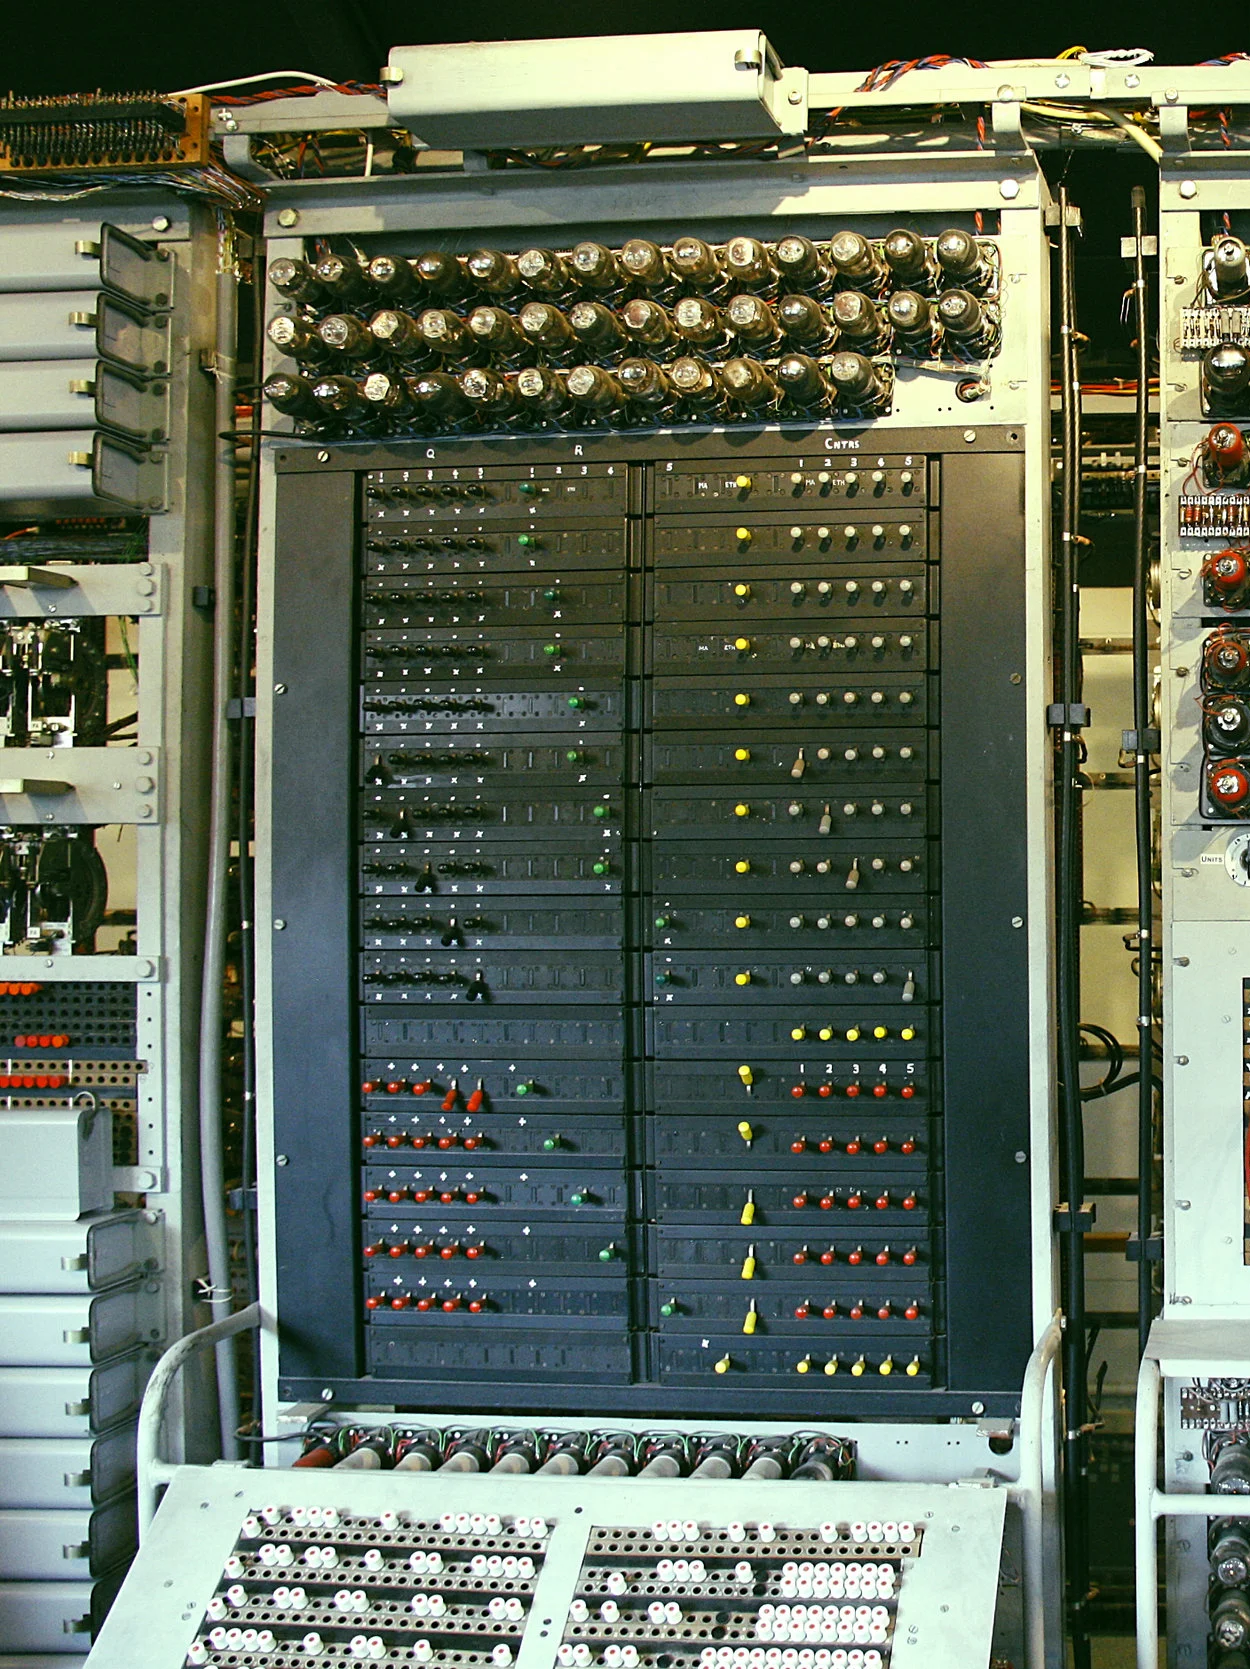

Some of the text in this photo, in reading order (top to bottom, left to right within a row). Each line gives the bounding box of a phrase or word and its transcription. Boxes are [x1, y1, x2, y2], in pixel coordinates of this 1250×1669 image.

[825, 438, 859, 449] CNTRS
[427, 449, 435, 459] Q
[575, 445, 583, 455] R
[666, 463, 672, 471] 5
[800, 459, 803, 467] 1
[851, 458, 857, 466] 3
[878, 458, 884, 467] 4
[905, 457, 912, 465] 5
[581, 466, 587, 475] 3
[800, 1063, 914, 1074] 1 2 3 4 5
